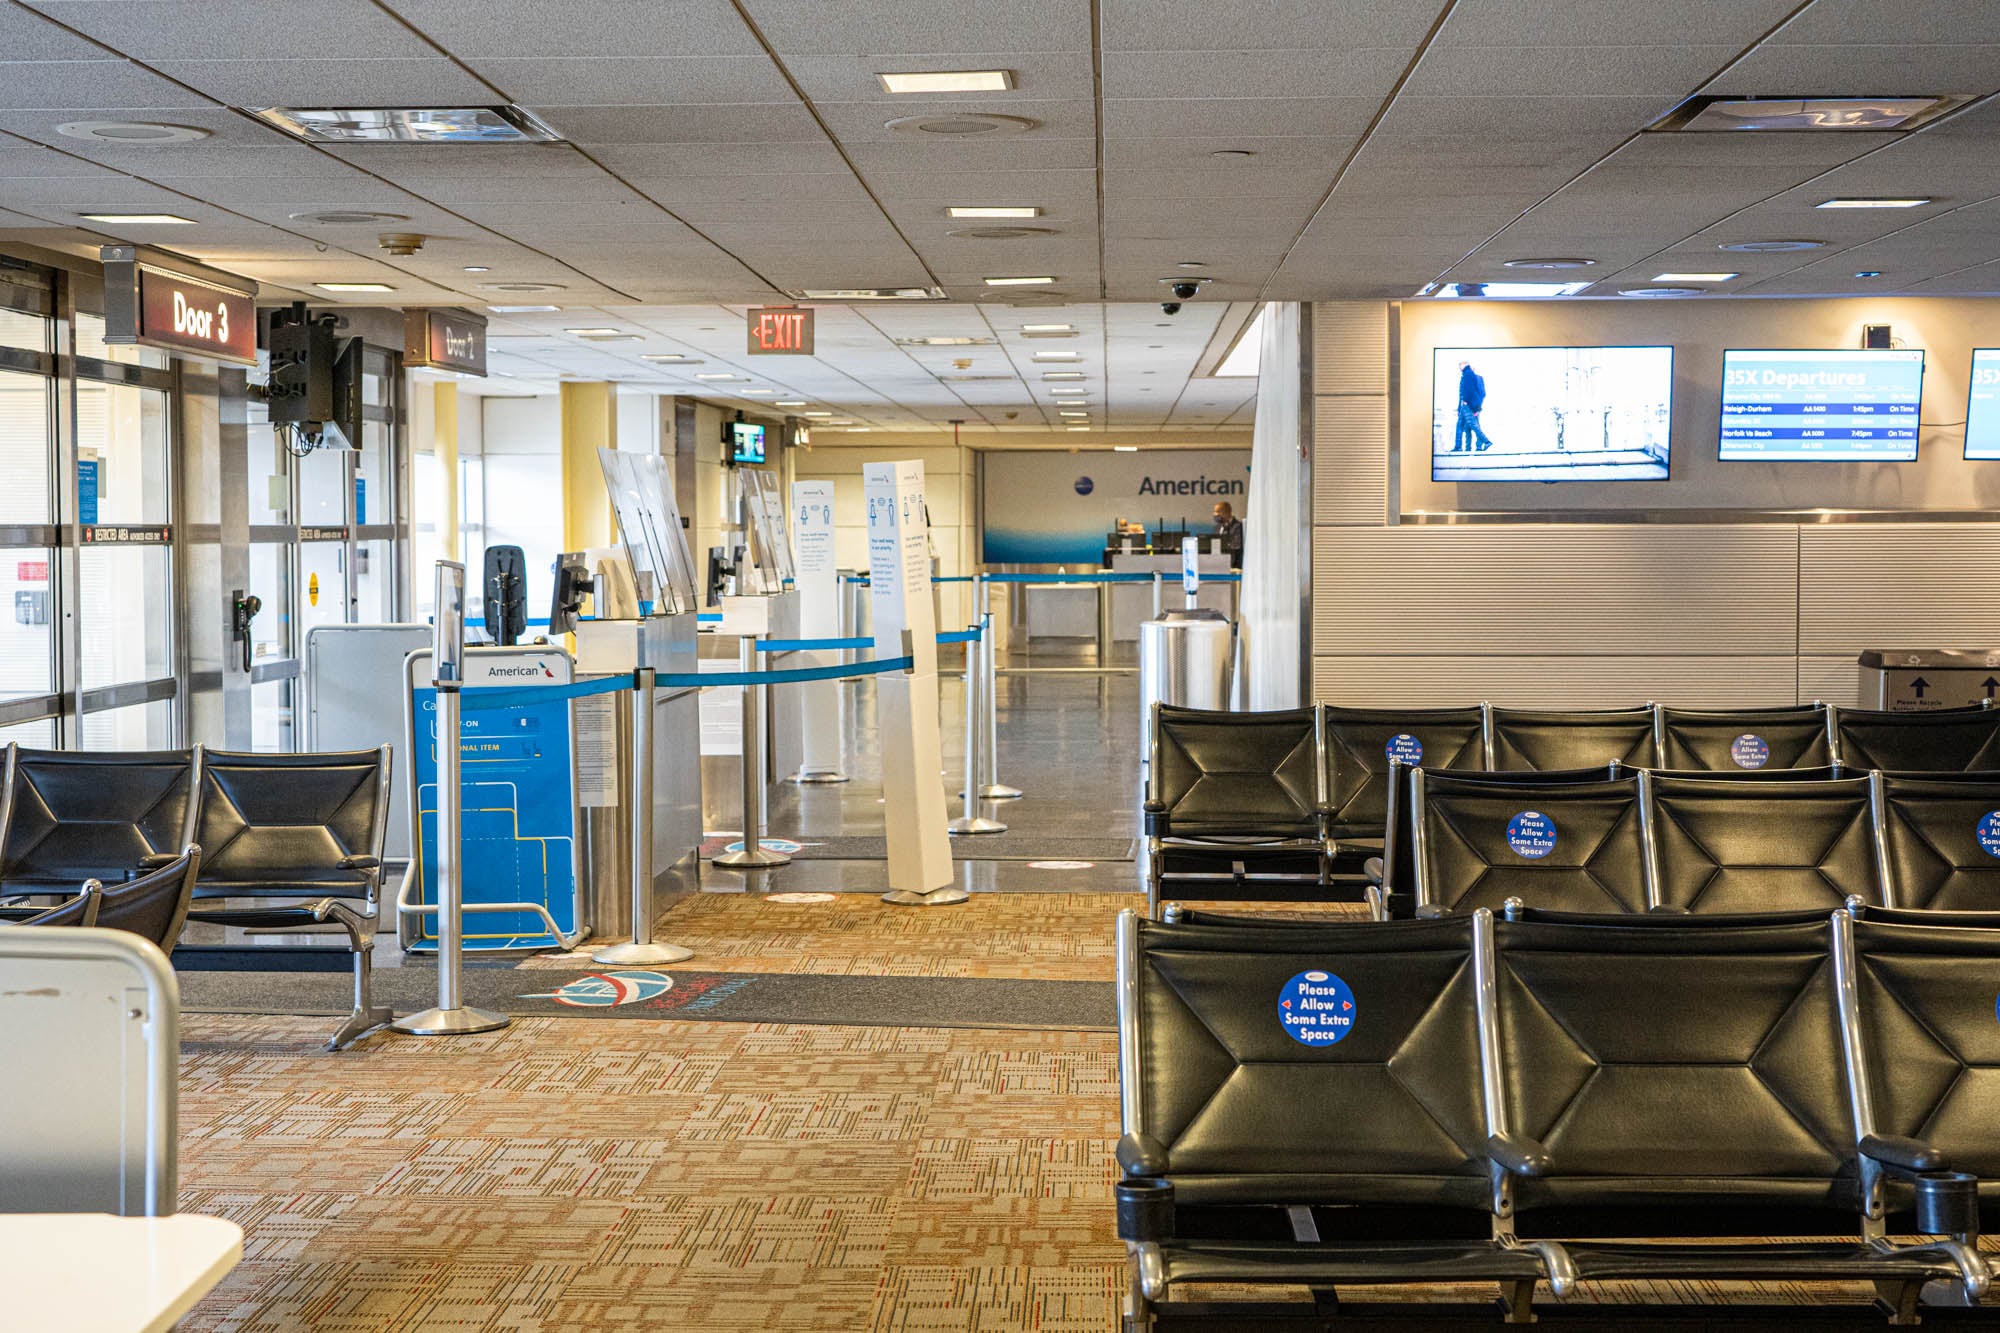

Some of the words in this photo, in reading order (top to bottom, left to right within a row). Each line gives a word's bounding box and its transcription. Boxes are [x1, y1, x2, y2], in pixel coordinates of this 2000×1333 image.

[173, 290, 213, 339] Door
[217, 302, 229, 343] 3
[760, 314, 806, 349] EXIT
[445, 326, 466, 358] Door
[467, 331, 475, 361] 2
[1762, 368, 1867, 391] Departures
[1723, 405, 1773, 414] Raleigh-Durham
[1889, 405, 1899, 413] On
[1900, 405, 1915, 413] Time
[1887, 430, 1897, 438] On
[1898, 430, 1914, 438] Time
[1138, 475, 1244, 496] American
[488, 666, 539, 677] American
[1520, 818, 1544, 828] Please
[1989, 818, 2000, 827] Ple
[1521, 828, 1543, 837] Allow
[1511, 836, 1531, 846] Some
[1533, 838, 1553, 847] Extra
[1982, 837, 2000, 845] Som
[1520, 846, 1544, 856] Space
[1298, 983, 1336, 996] Please
[1300, 997, 1335, 1011] Allow
[1285, 1012, 1317, 1025] Some
[1320, 1013, 1350, 1026] Extra
[1300, 1027, 1336, 1042] Space
